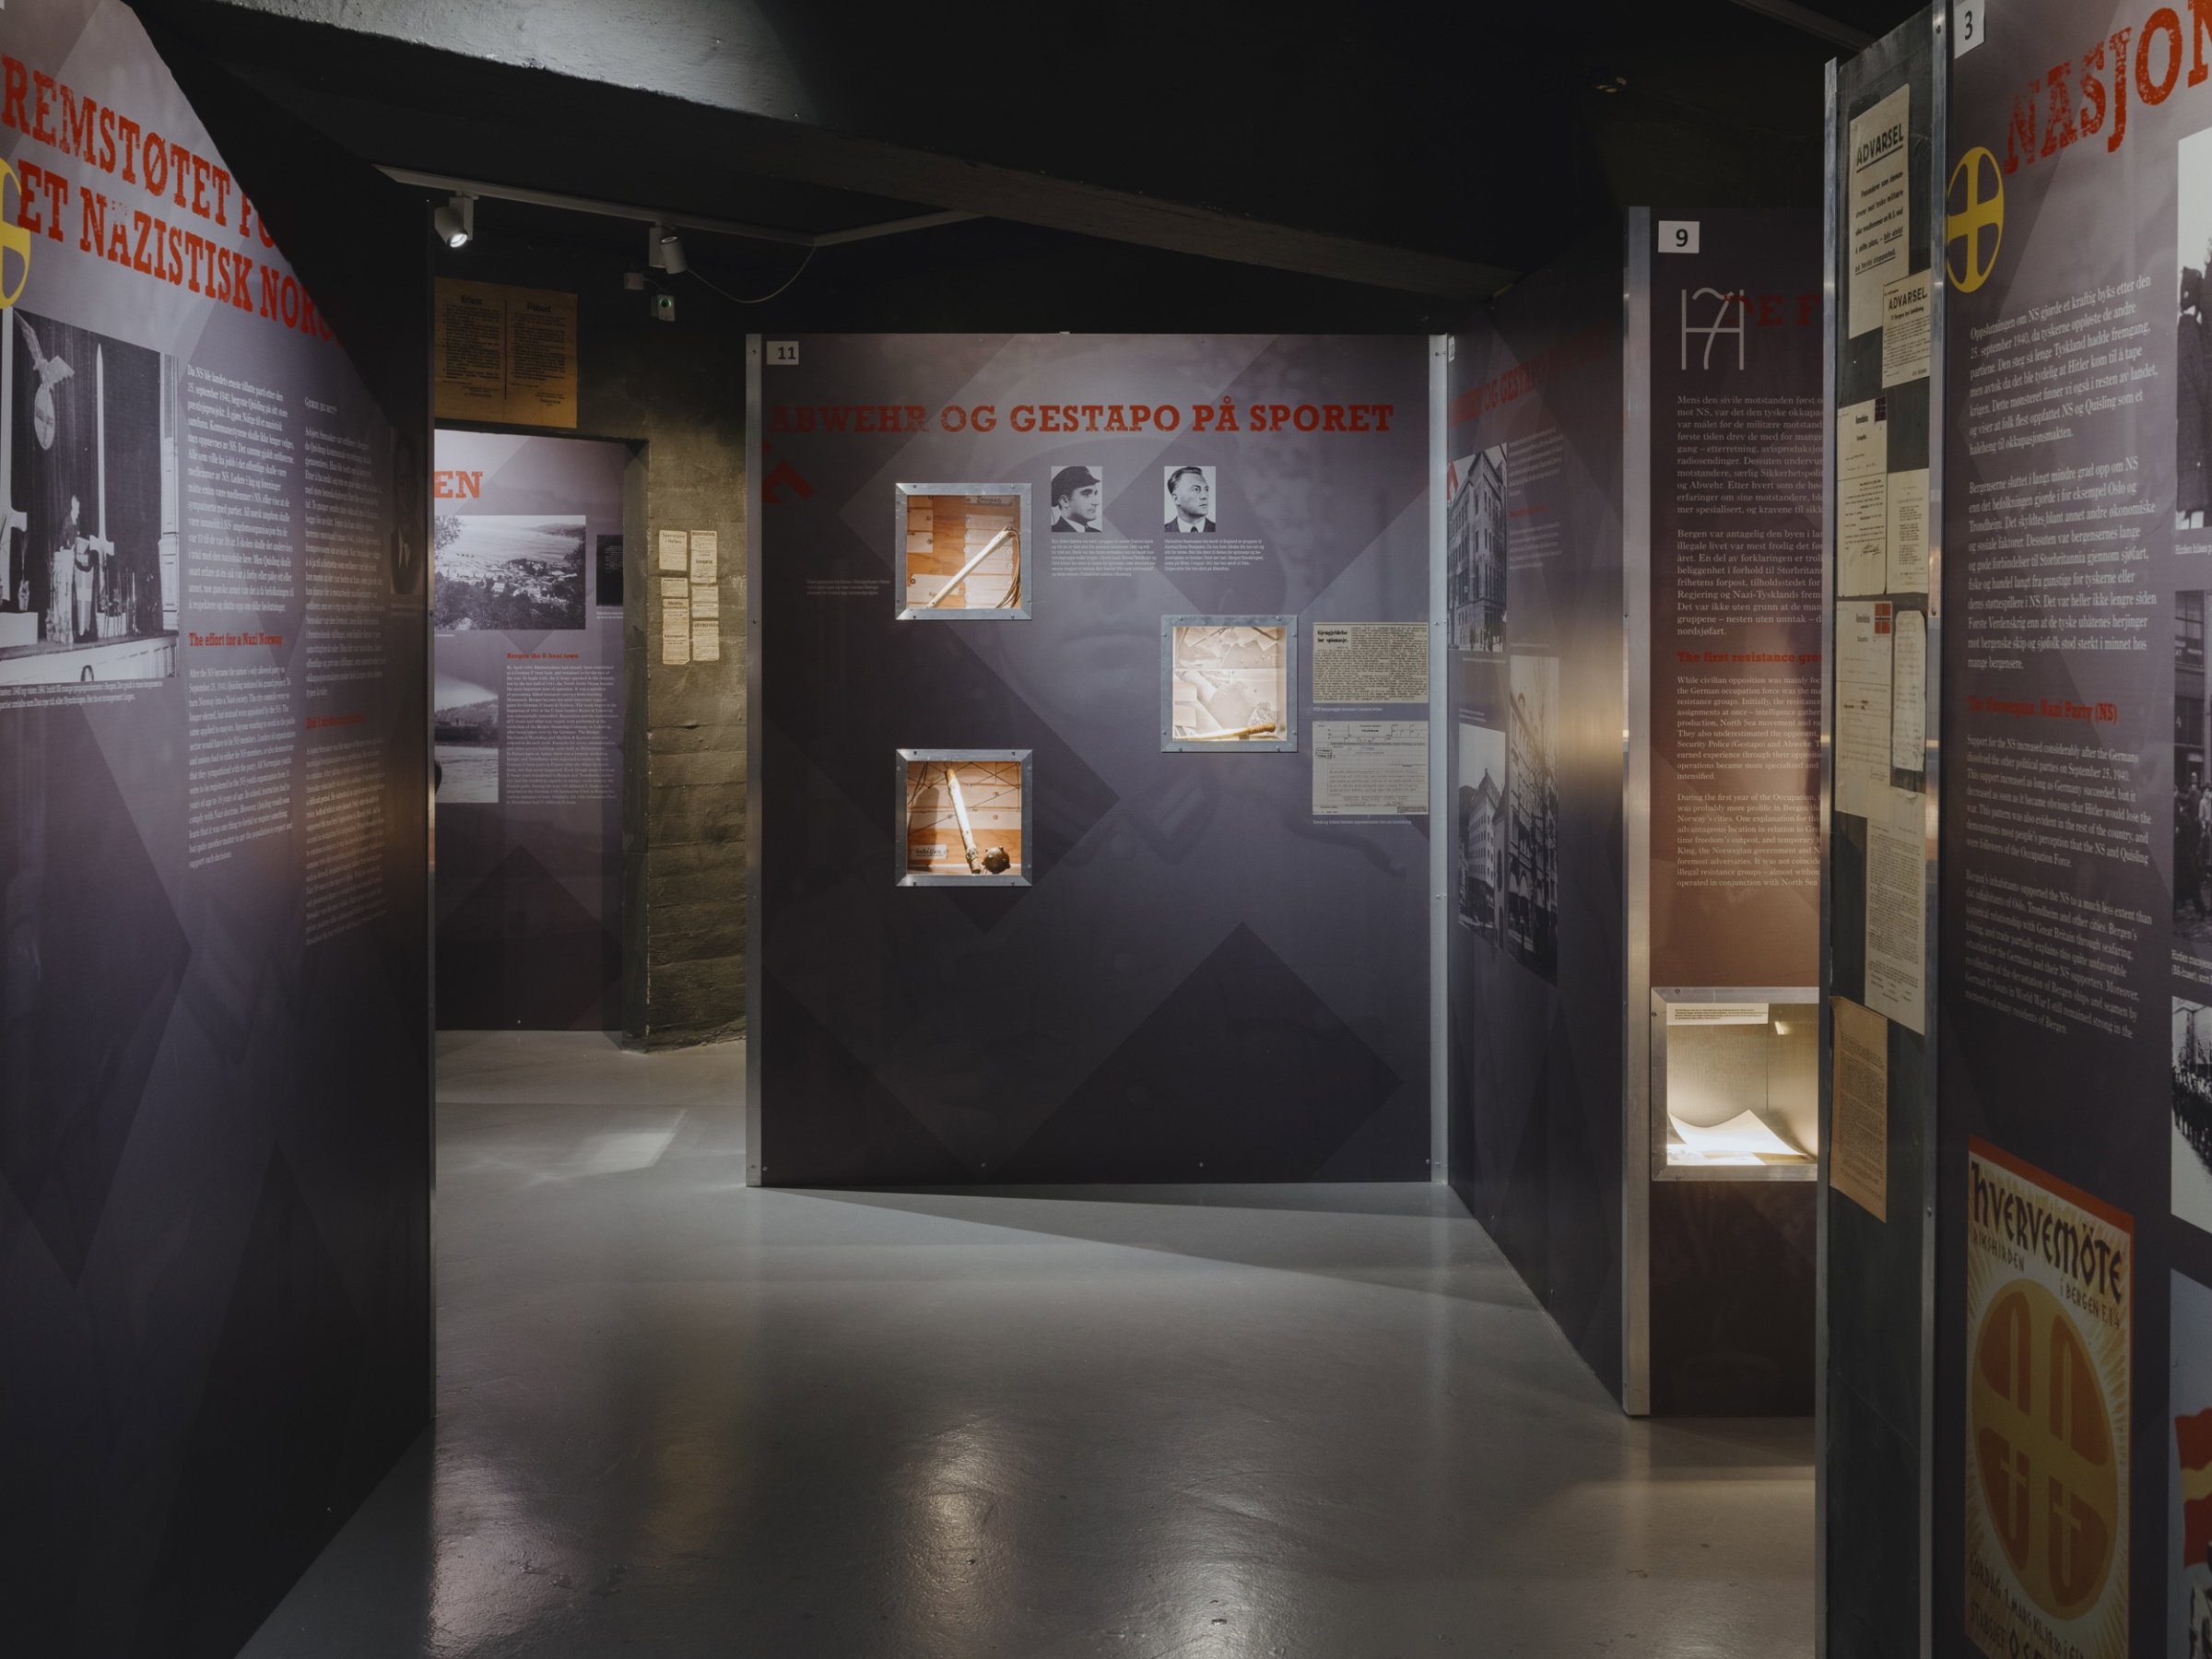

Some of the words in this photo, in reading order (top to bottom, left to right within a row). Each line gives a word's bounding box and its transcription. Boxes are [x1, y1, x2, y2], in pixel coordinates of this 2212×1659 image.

[1964, 10, 1973, 41] 3
[2, 53, 230, 227] REMSTØTET
[1856, 123, 1903, 167] ADVARSEL
[18, 159, 68, 242] ET
[80, 185, 253, 312] NAZISTISK
[1676, 229, 1688, 247] 9
[2017, 313, 2027, 325] om
[2029, 306, 2039, 322] NS
[2063, 297, 2071, 312] et
[2072, 290, 2097, 309] kraftig
[2098, 285, 2115, 304] byks
[2116, 280, 2135, 296] etter
[2136, 275, 2152, 290] den
[777, 347, 796, 360] 11
[1998, 357, 2011, 371] Den
[2054, 335, 2086, 359] Tyskland
[2087, 331, 2110, 348] hadde
[2112, 324, 2150, 342] fremgang,
[1677, 395, 1700, 404] Mens
[1702, 395, 1717, 404] den
[1720, 395, 1741, 404] sivile
[1745, 395, 1793, 404] motstanden
[1795, 395, 1815, 404] først
[768, 405, 929, 433] ABWEHR
[940, 405, 997, 432] OG
[1009, 405, 1181, 433] GESTAPO
[1192, 395, 1240, 432] PÅ
[1250, 405, 1394, 432] SPORET
[1978, 419, 1994, 434] viser
[2002, 413, 2015, 429] folk
[2030, 405, 2061, 427] oppfattet
[2062, 402, 2074, 418] NS
[2075, 405, 2084, 418] og
[2085, 394, 2116, 417] Quisling
[2118, 394, 2134, 406] som
[2135, 388, 2143, 403] et
[1694, 419, 1716, 428] målet
[1720, 419, 1732, 428] for
[1734, 419, 1744, 428] de
[1747, 419, 1781, 428] militære
[1677, 431, 1700, 441] første
[1703, 431, 1724, 441] tiden
[1726, 431, 1745, 441] drev
[1748, 431, 1758, 441] de
[1760, 431, 1778, 441] med
[1781, 431, 1793, 441] for
[1795, 433, 1822, 441] mange
[1677, 482, 1687, 490] og
[1689, 480, 1724, 488] Abwehr.
[1728, 480, 1748, 488] Etter
[1752, 480, 1773, 488] hvert
[1795, 480, 1806, 488] de
[1696, 505, 1744, 515] spesialisert,
[1747, 507, 1756, 515] og
[1759, 505, 1792, 513] kravene
[1794, 505, 1805, 513] til
[2006, 513, 2017, 528] Det
[2018, 512, 2044, 530] skyldtes
[2046, 509, 2064, 524] blant
[2065, 507, 2085, 523] annet
[2087, 505, 2107, 521] andre
[2109, 500, 2156, 518] økonomiske
[1677, 529, 1707, 539] Bergen
[1726, 529, 1764, 539] antagelig
[1767, 529, 1782, 537] den
[1784, 529, 1804, 539] byen
[1807, 529, 1810, 537] i
[1678, 590, 1718, 600] Regjering
[1721, 592, 1730, 600] og
[1733, 590, 1799, 600] Nazi-Tysklands
[1677, 602, 1691, 610] Det
[1712, 602, 1729, 610] ikke
[1732, 602, 1750, 610] uten
[1753, 604, 1778, 612] grunn
[1780, 602, 1788, 610] at
[1791, 602, 1801, 610] de
[1677, 627, 1725, 636] nordsjøfart.
[189, 632, 204, 646] The
[205, 632, 224, 645] effort
[226, 633, 236, 645] for
[237, 637, 241, 645] a
[242, 632, 258, 645] Nazi
[259, 632, 283, 648] Norway
[1677, 652, 1700, 663] The
[1703, 652, 1731, 663] first
[1732, 653, 1795, 663] resistance
[1677, 676, 1699, 684] While
[1700, 676, 1726, 684] civilian
[1729, 676, 1765, 686] opposition
[1783, 676, 1808, 686] mainly
[2040, 700, 2063, 717] Nazi
[2064, 701, 2093, 724] Party
[2095, 703, 2117, 725] (NS)
[1677, 740, 1706, 749] Security
[1731, 740, 1766, 749] (Gestapo)
[1678, 846, 1697, 856] King,
[1699, 846, 1710, 854] the
[1712, 846, 1751, 856] Norwegian
[1753, 846, 1795, 856] government
[1798, 846, 1812, 854] and
